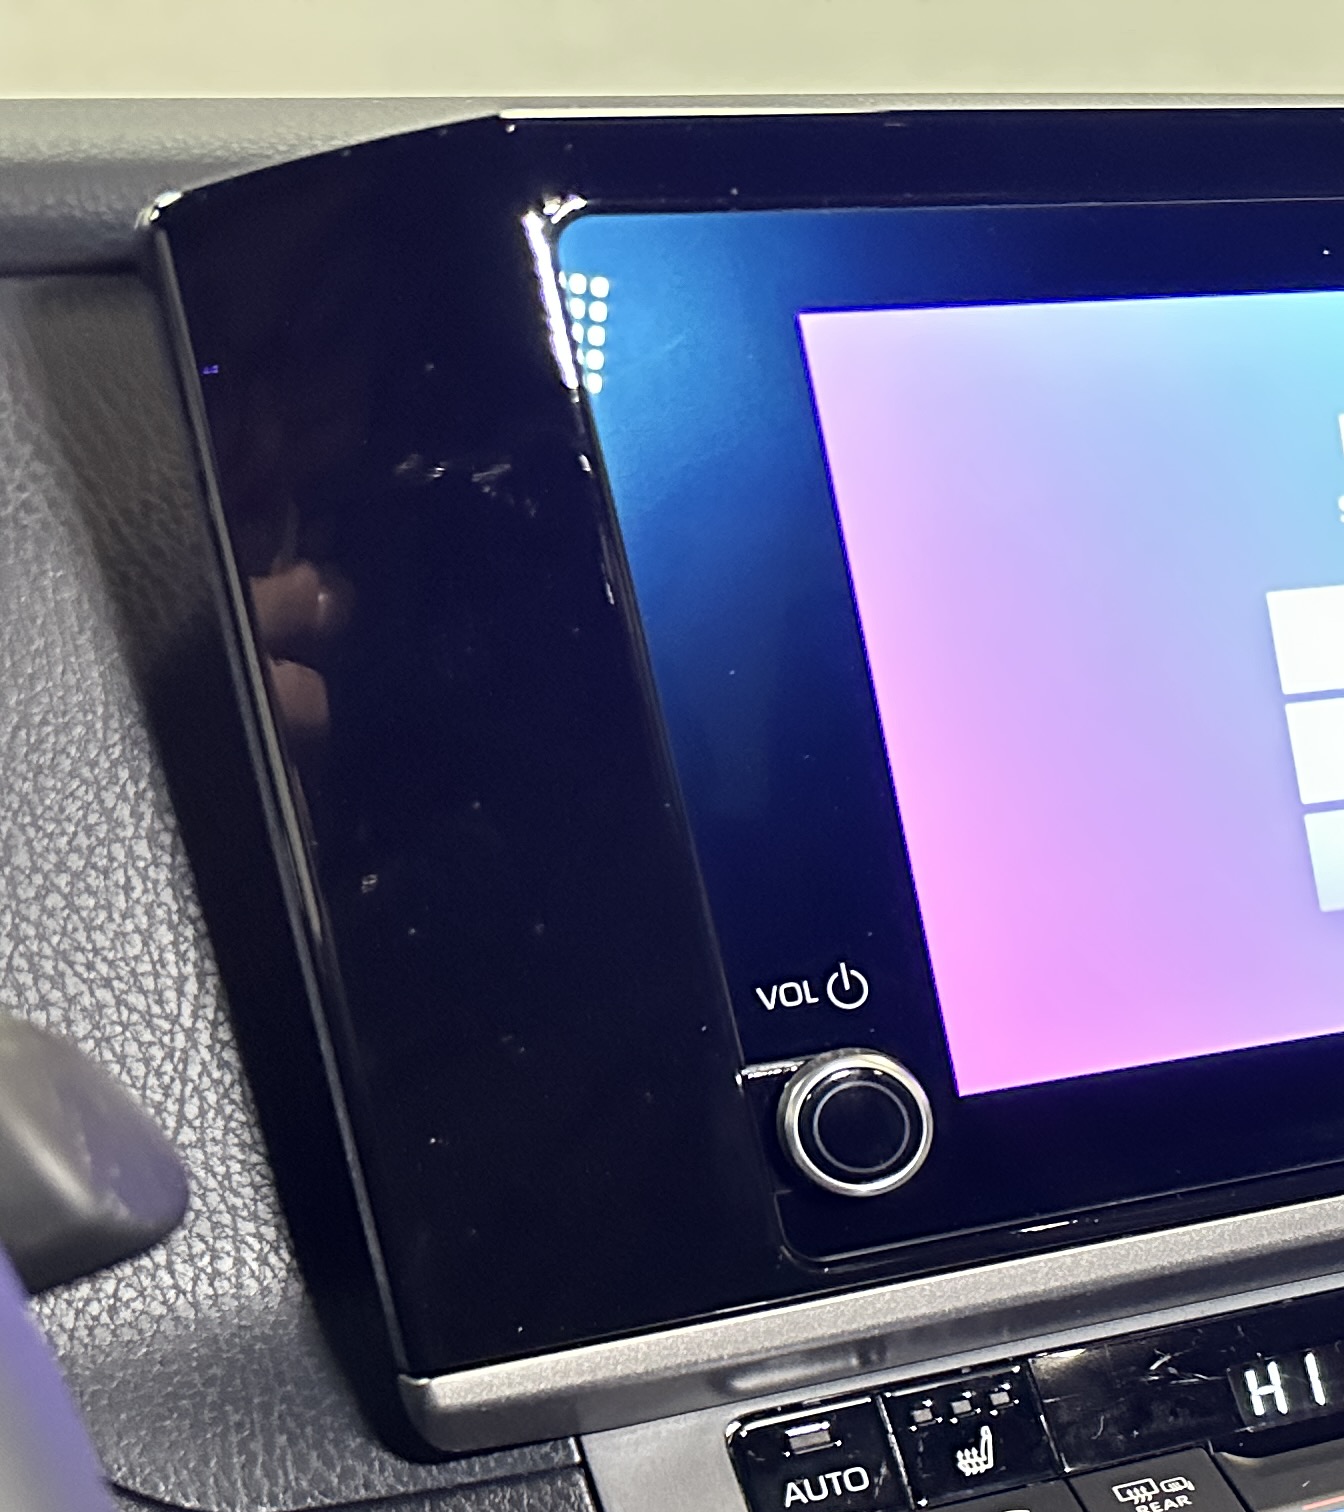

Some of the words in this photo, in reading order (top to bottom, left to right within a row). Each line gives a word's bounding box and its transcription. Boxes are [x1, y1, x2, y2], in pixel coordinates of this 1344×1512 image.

[756, 980, 819, 1011] VOL
[1245, 1350, 1327, 1416] HI
[783, 1466, 869, 1508] AUTO
